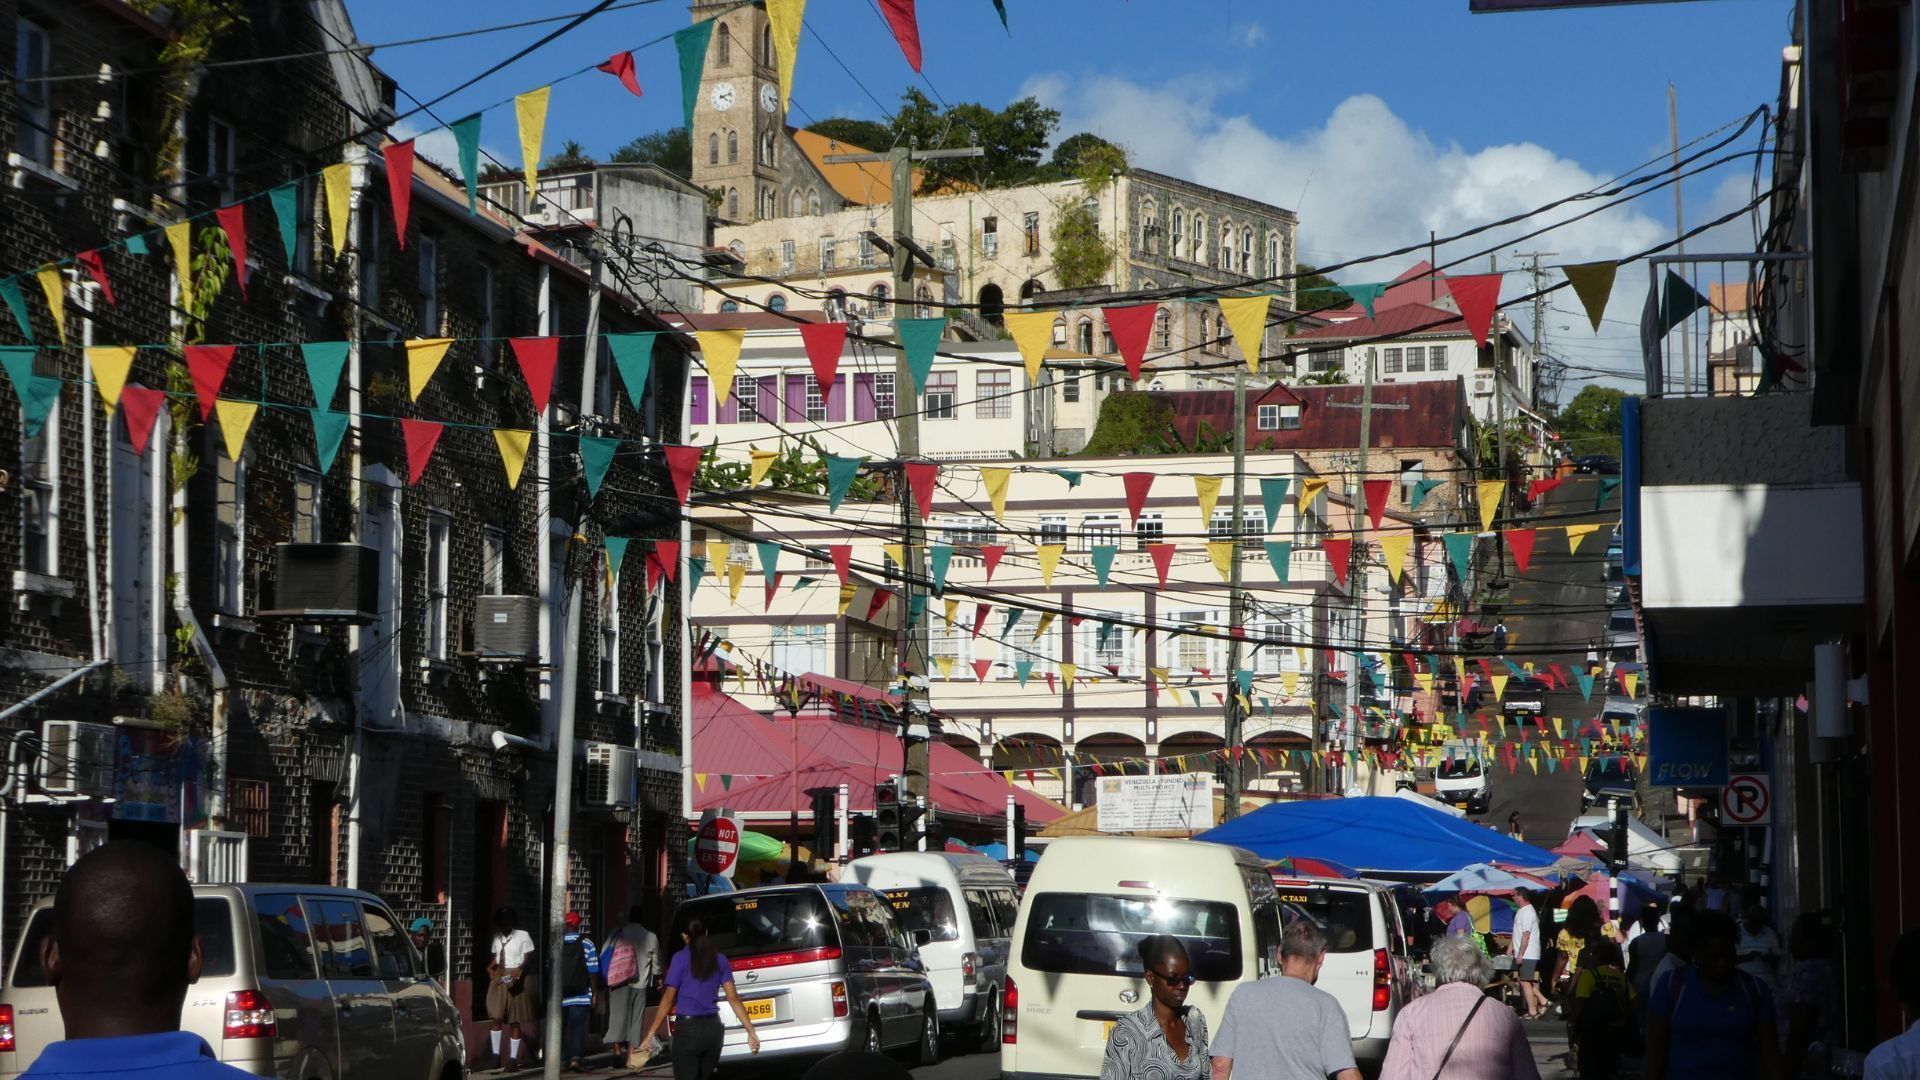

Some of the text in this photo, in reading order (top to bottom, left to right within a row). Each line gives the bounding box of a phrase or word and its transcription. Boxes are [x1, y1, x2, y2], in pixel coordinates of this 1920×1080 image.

[1657, 762, 1713, 780] FLOW
[703, 827, 737, 840] DO NOT
[703, 852, 728, 865] ENTER
